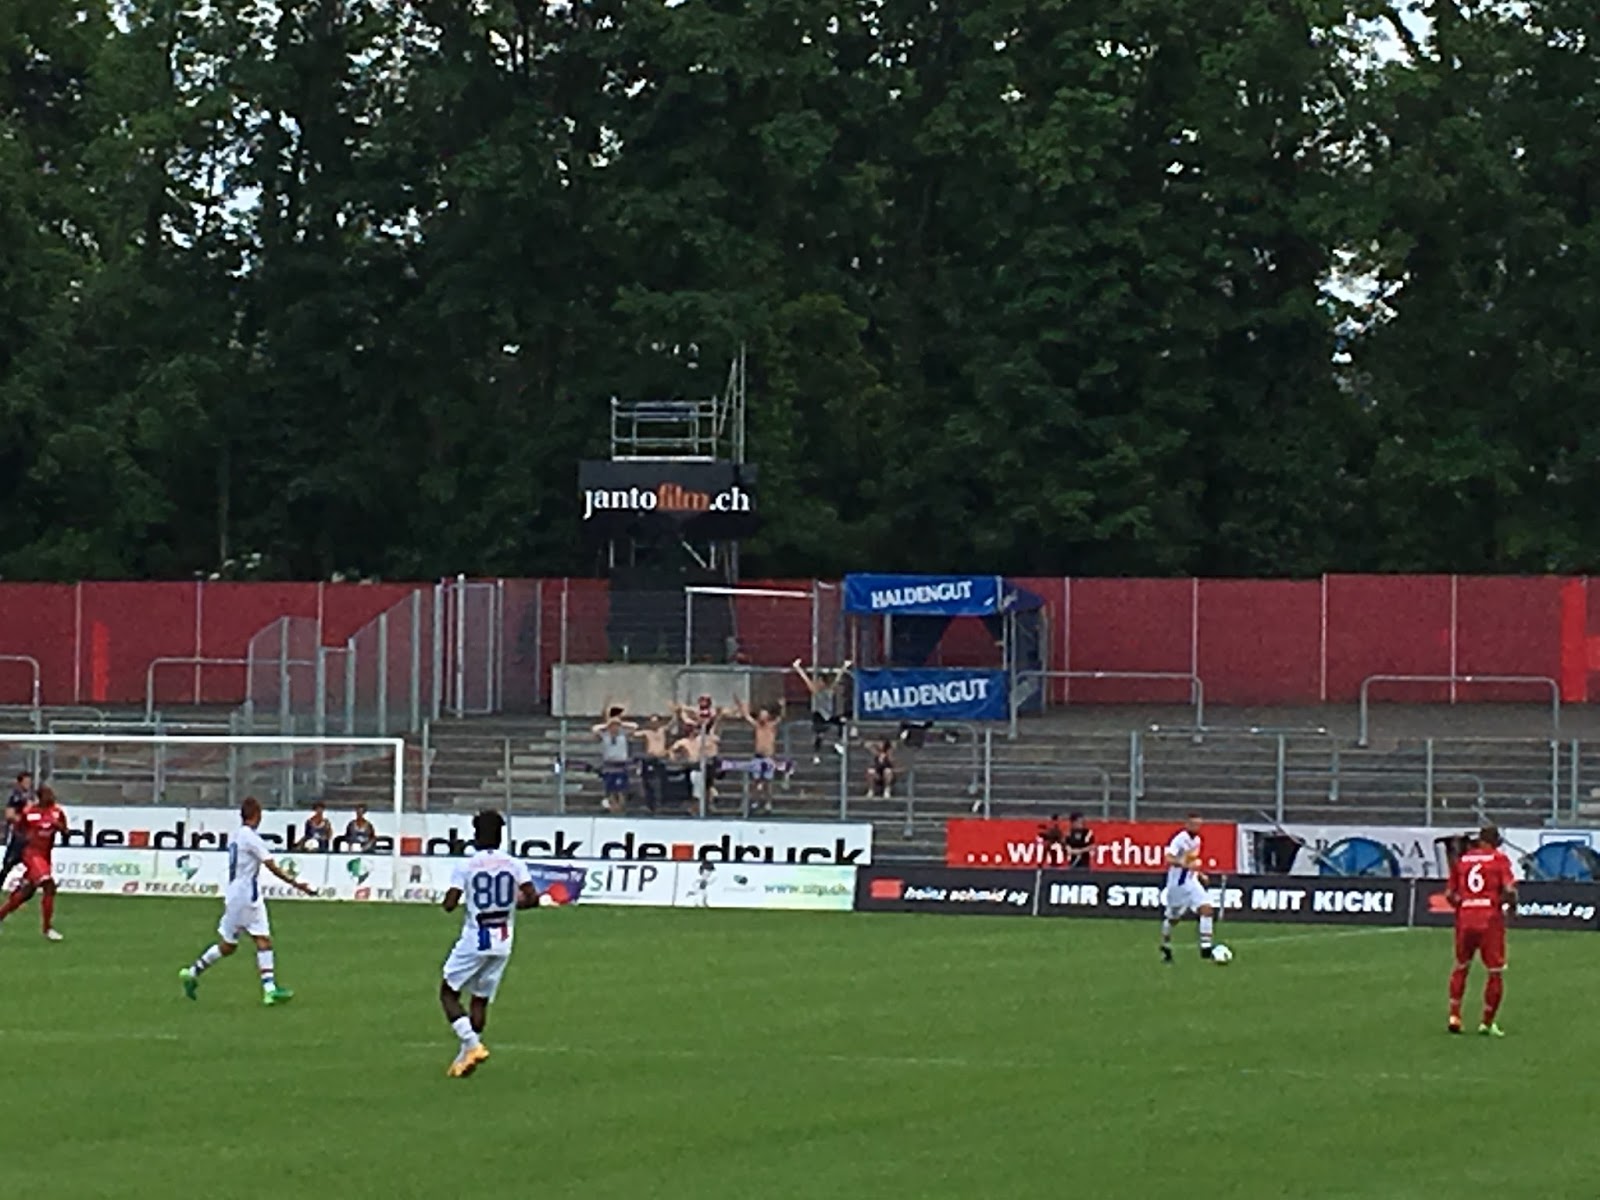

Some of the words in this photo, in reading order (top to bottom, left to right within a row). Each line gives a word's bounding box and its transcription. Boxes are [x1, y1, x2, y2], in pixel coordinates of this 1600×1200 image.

[582, 482, 750, 520] jantofilm.ch
[870, 580, 973, 609] HALDENGUT
[863, 678, 989, 712] HALDENGUT
[144, 881, 219, 895] TELECLUB
[472, 871, 515, 910] 80
[1467, 863, 1485, 893] 6
[1050, 883, 1100, 906] IHR
[1251, 888, 1307, 911] MIT
[1313, 890, 1394, 913] KICK!
